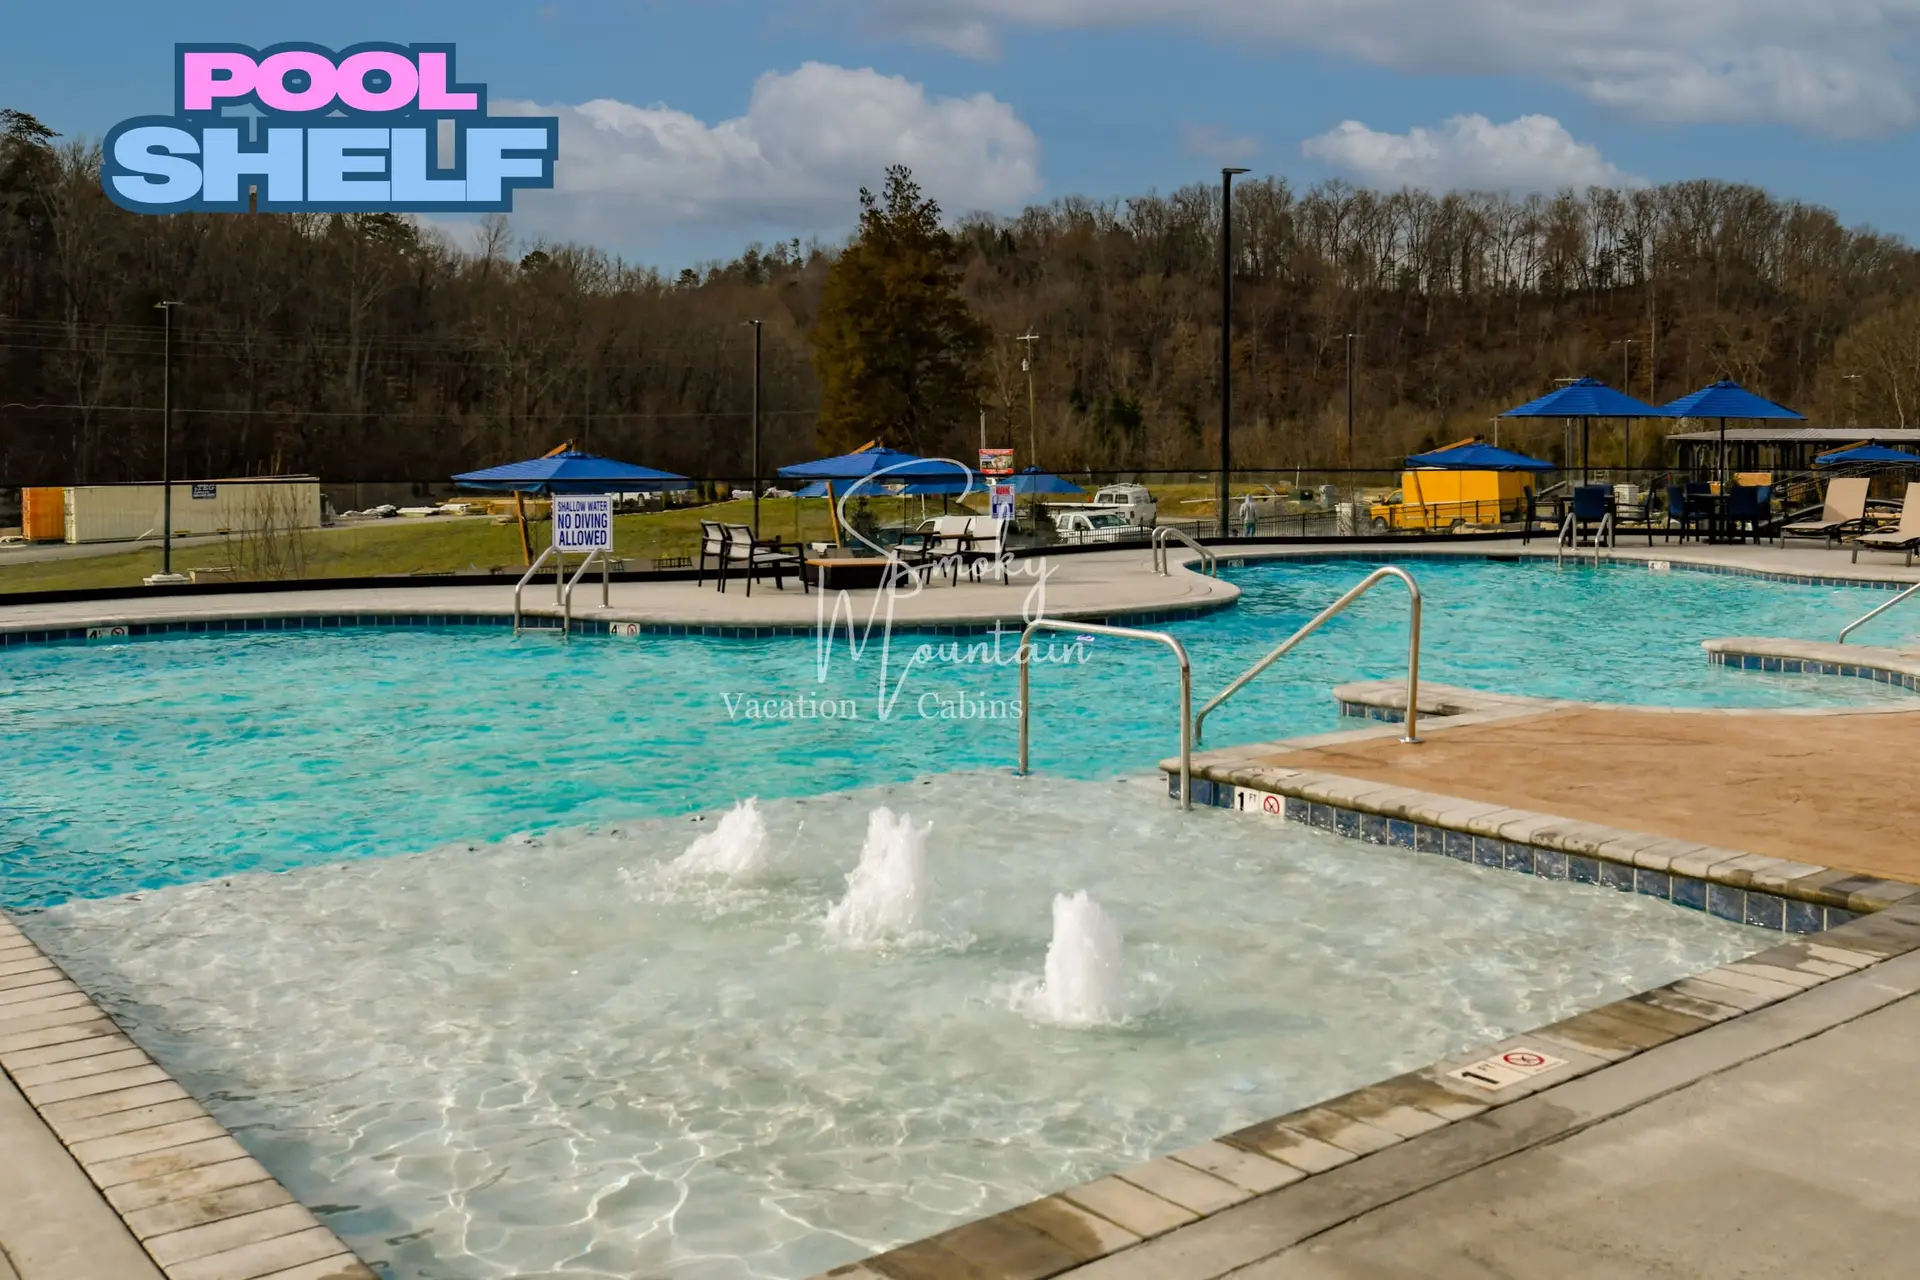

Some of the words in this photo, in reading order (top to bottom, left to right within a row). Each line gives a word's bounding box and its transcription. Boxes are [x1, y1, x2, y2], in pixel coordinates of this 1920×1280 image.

[558, 501, 586, 512] SHALLOW
[588, 501, 607, 511] WATER
[558, 513, 571, 529] NO
[575, 513, 607, 529] DIVING
[559, 530, 607, 546] ALLOWED
